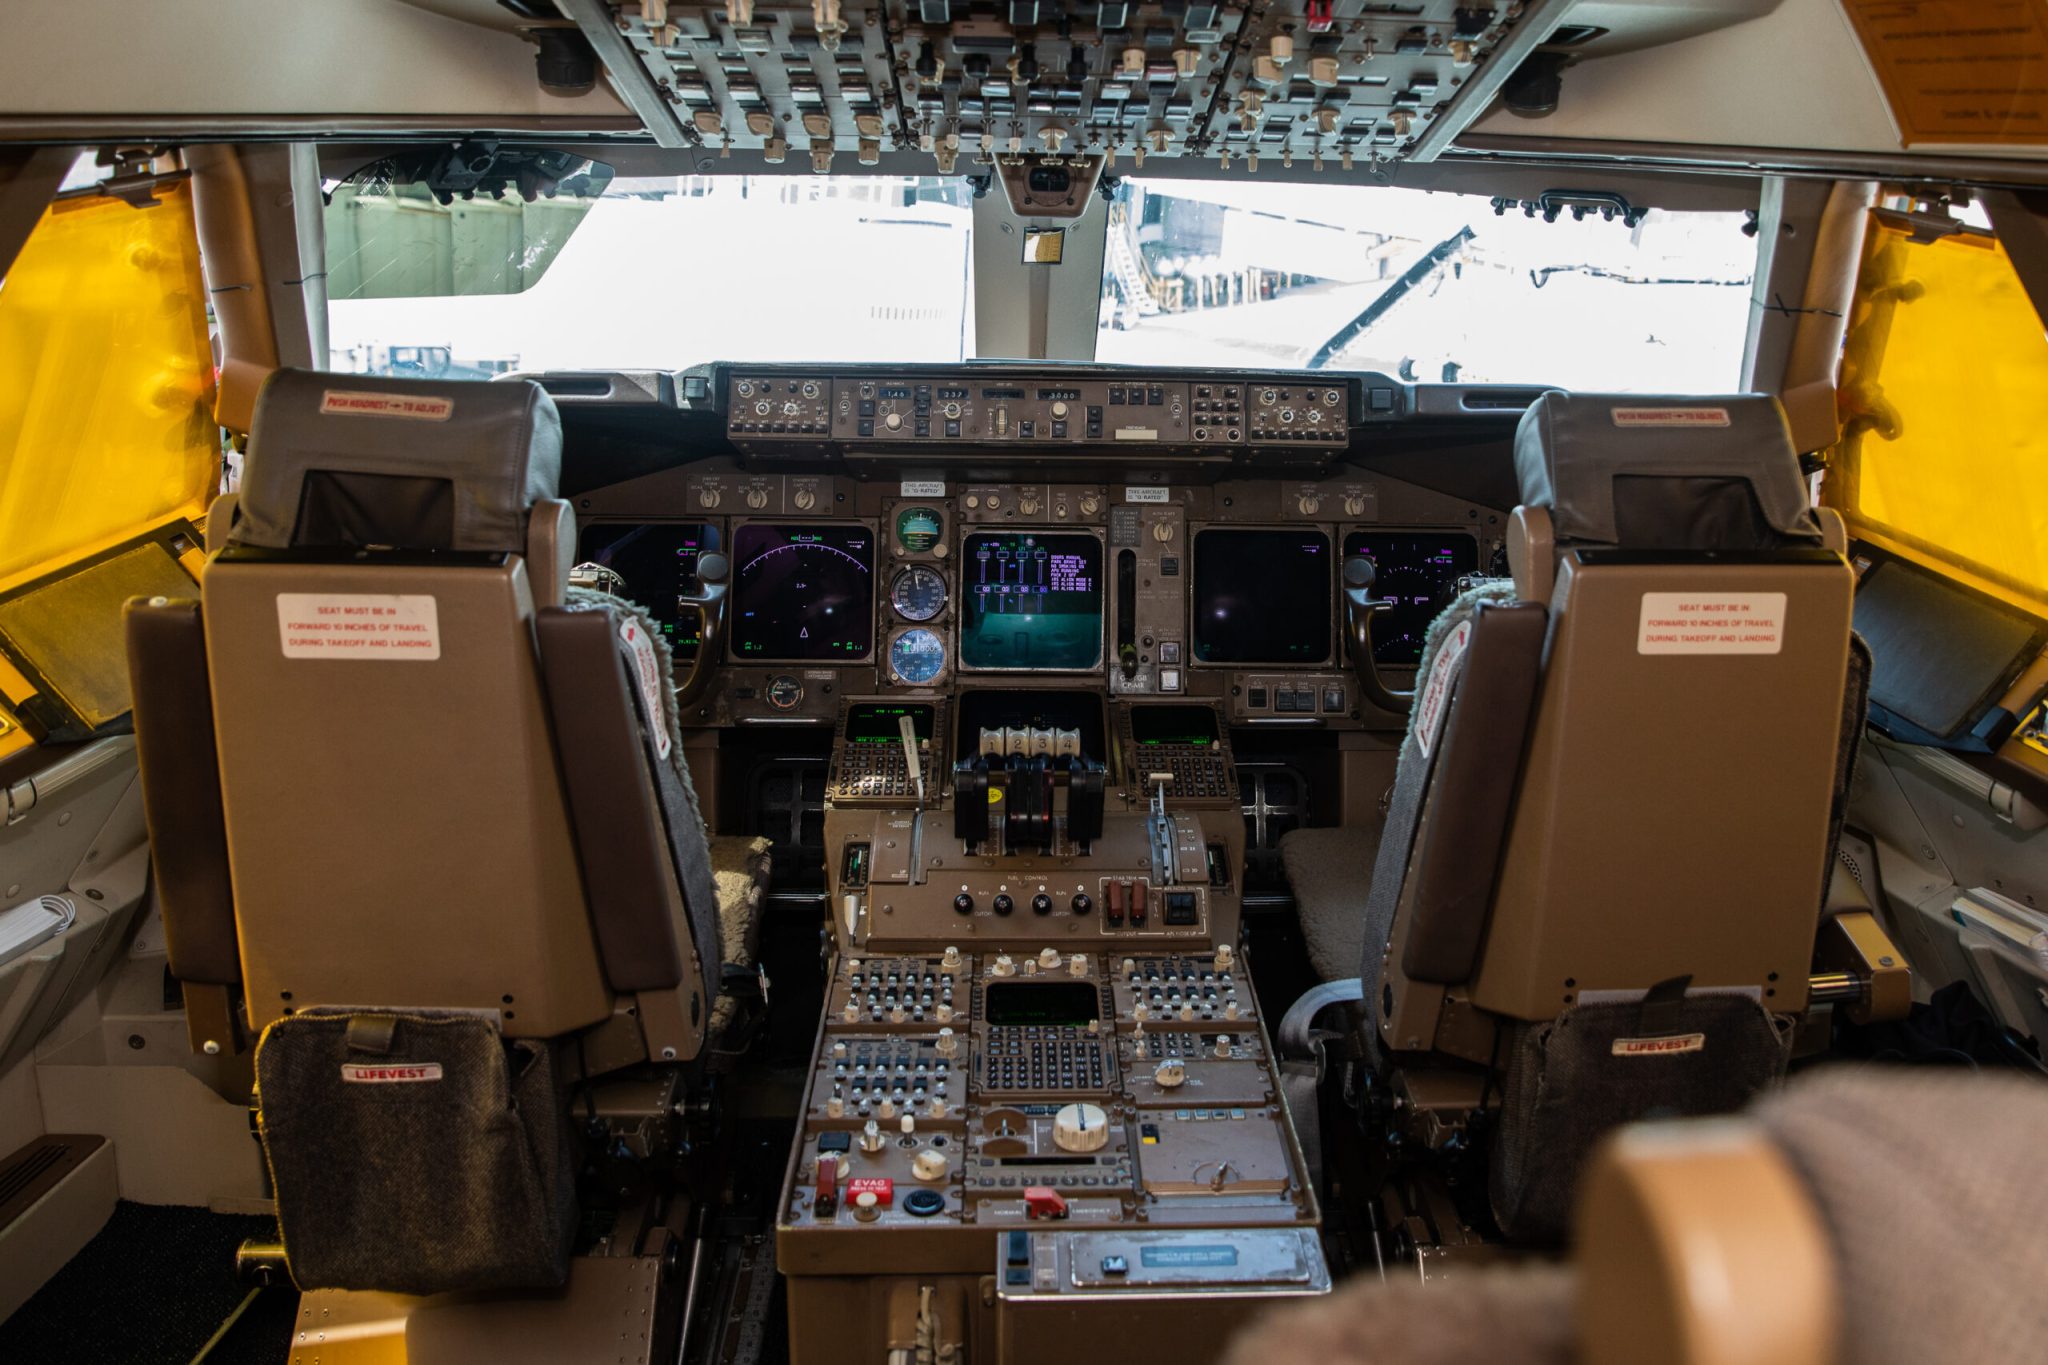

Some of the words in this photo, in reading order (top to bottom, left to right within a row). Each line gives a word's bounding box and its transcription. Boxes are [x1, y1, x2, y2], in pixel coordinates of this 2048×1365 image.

[989, 742, 994, 750] 1
[1014, 738, 1022, 750] 2
[1039, 738, 1047, 748] 3
[1064, 740, 1072, 749] 4
[1626, 1040, 1692, 1051] LIFEVEST
[355, 1069, 426, 1079] LIFEVEST
